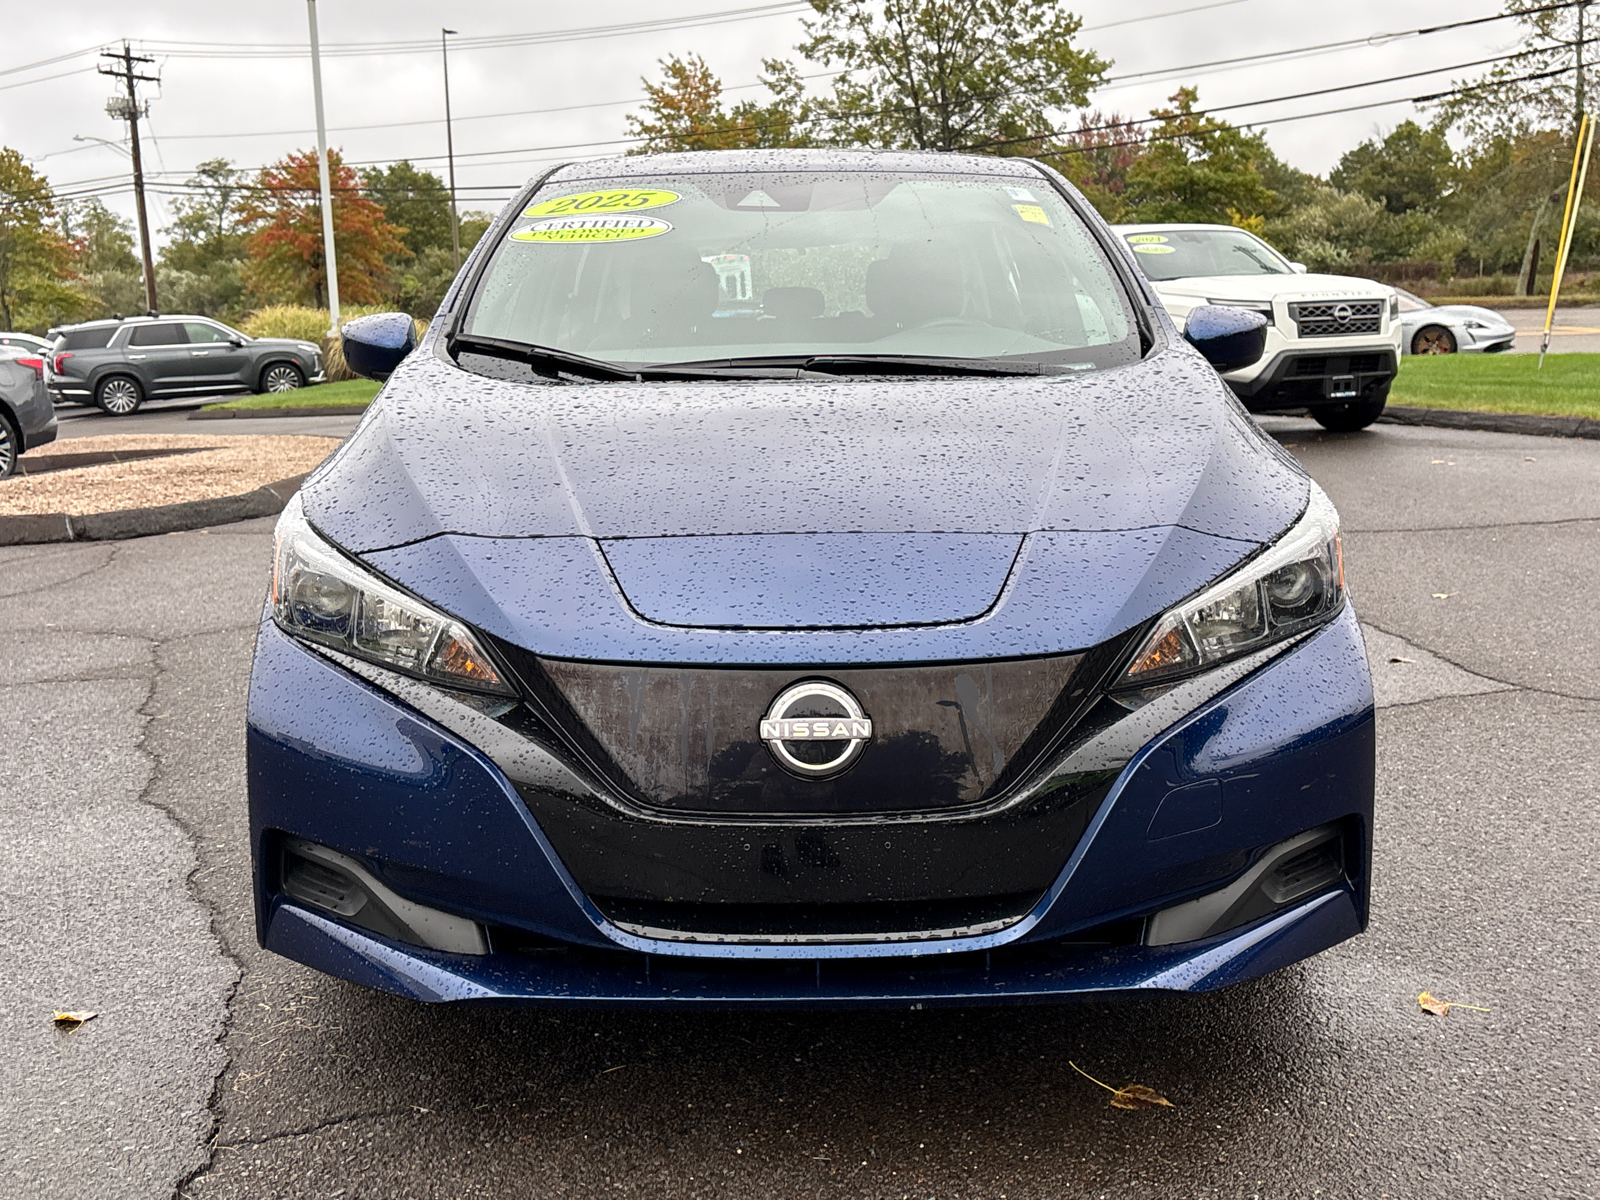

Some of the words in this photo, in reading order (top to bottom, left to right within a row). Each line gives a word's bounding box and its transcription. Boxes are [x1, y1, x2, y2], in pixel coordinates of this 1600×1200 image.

[546, 192, 657, 214] 2025
[530, 219, 655, 232] CERTIFIED
[531, 228, 646, 237] PRE-OWNED
[763, 722, 869, 737] NISSAN
